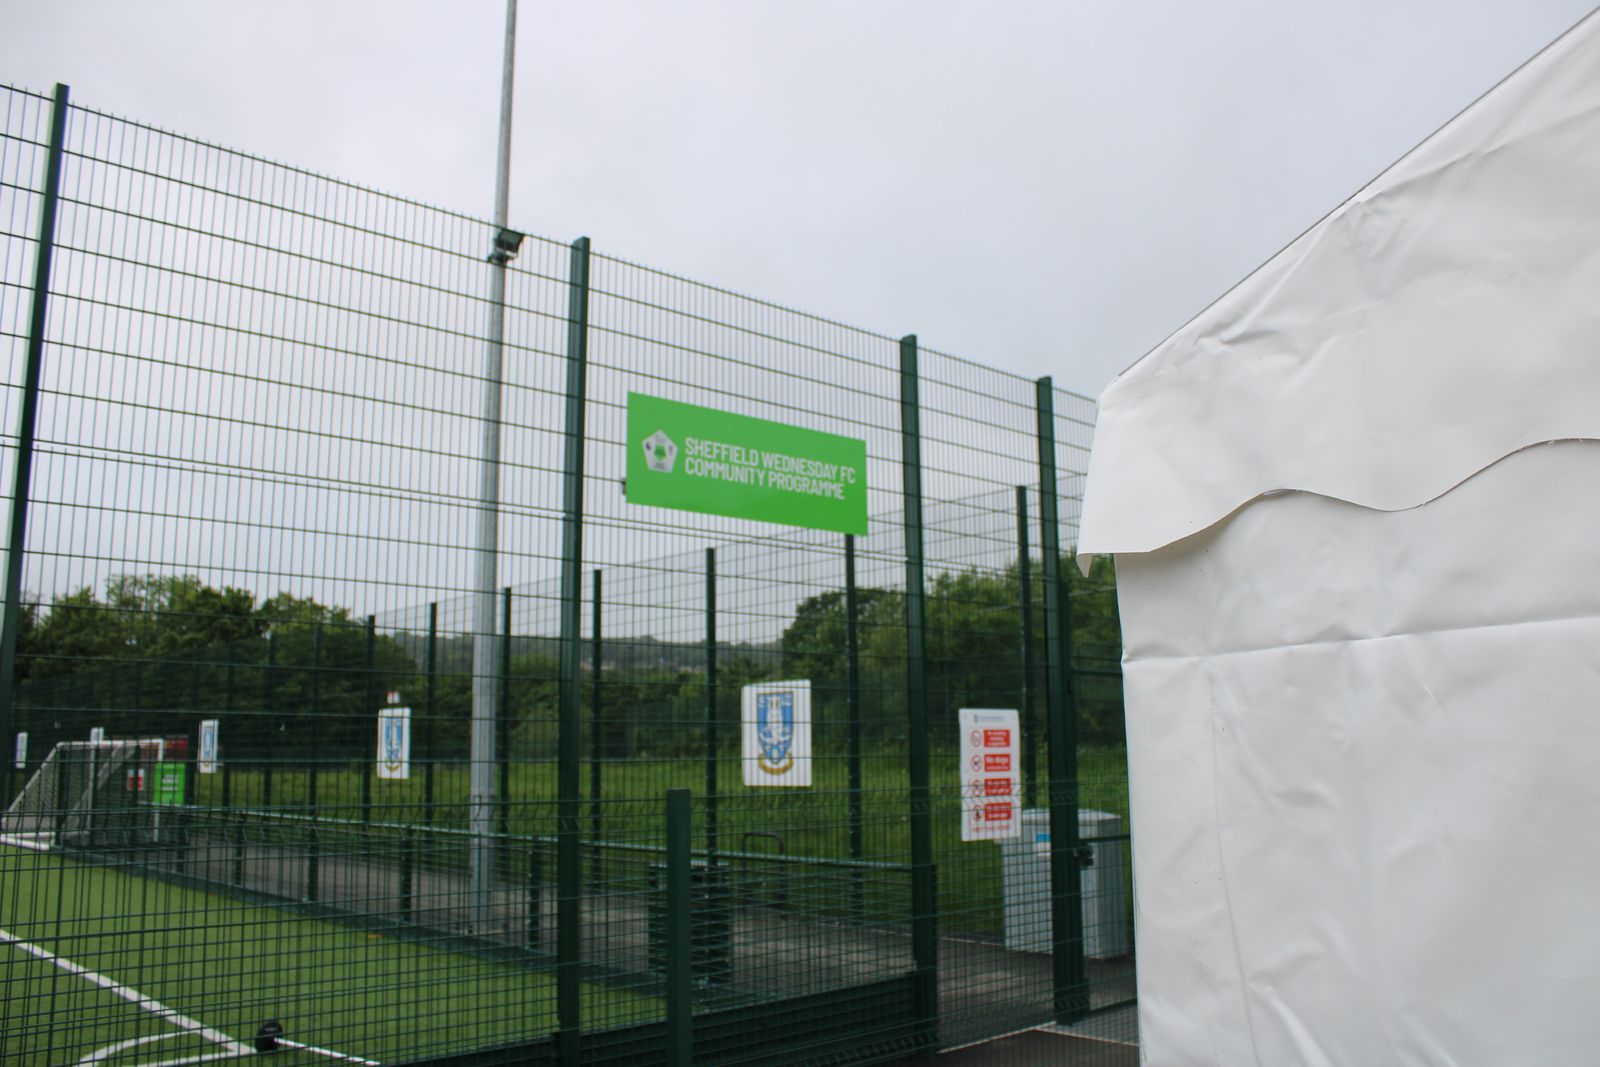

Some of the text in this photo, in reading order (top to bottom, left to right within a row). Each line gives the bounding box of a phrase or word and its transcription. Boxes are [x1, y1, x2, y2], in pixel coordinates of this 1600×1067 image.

[685, 437, 856, 484] SHEFFIELD WEDNESDAY FC
[685, 457, 845, 500] COMMUNITY PROGRAMME
